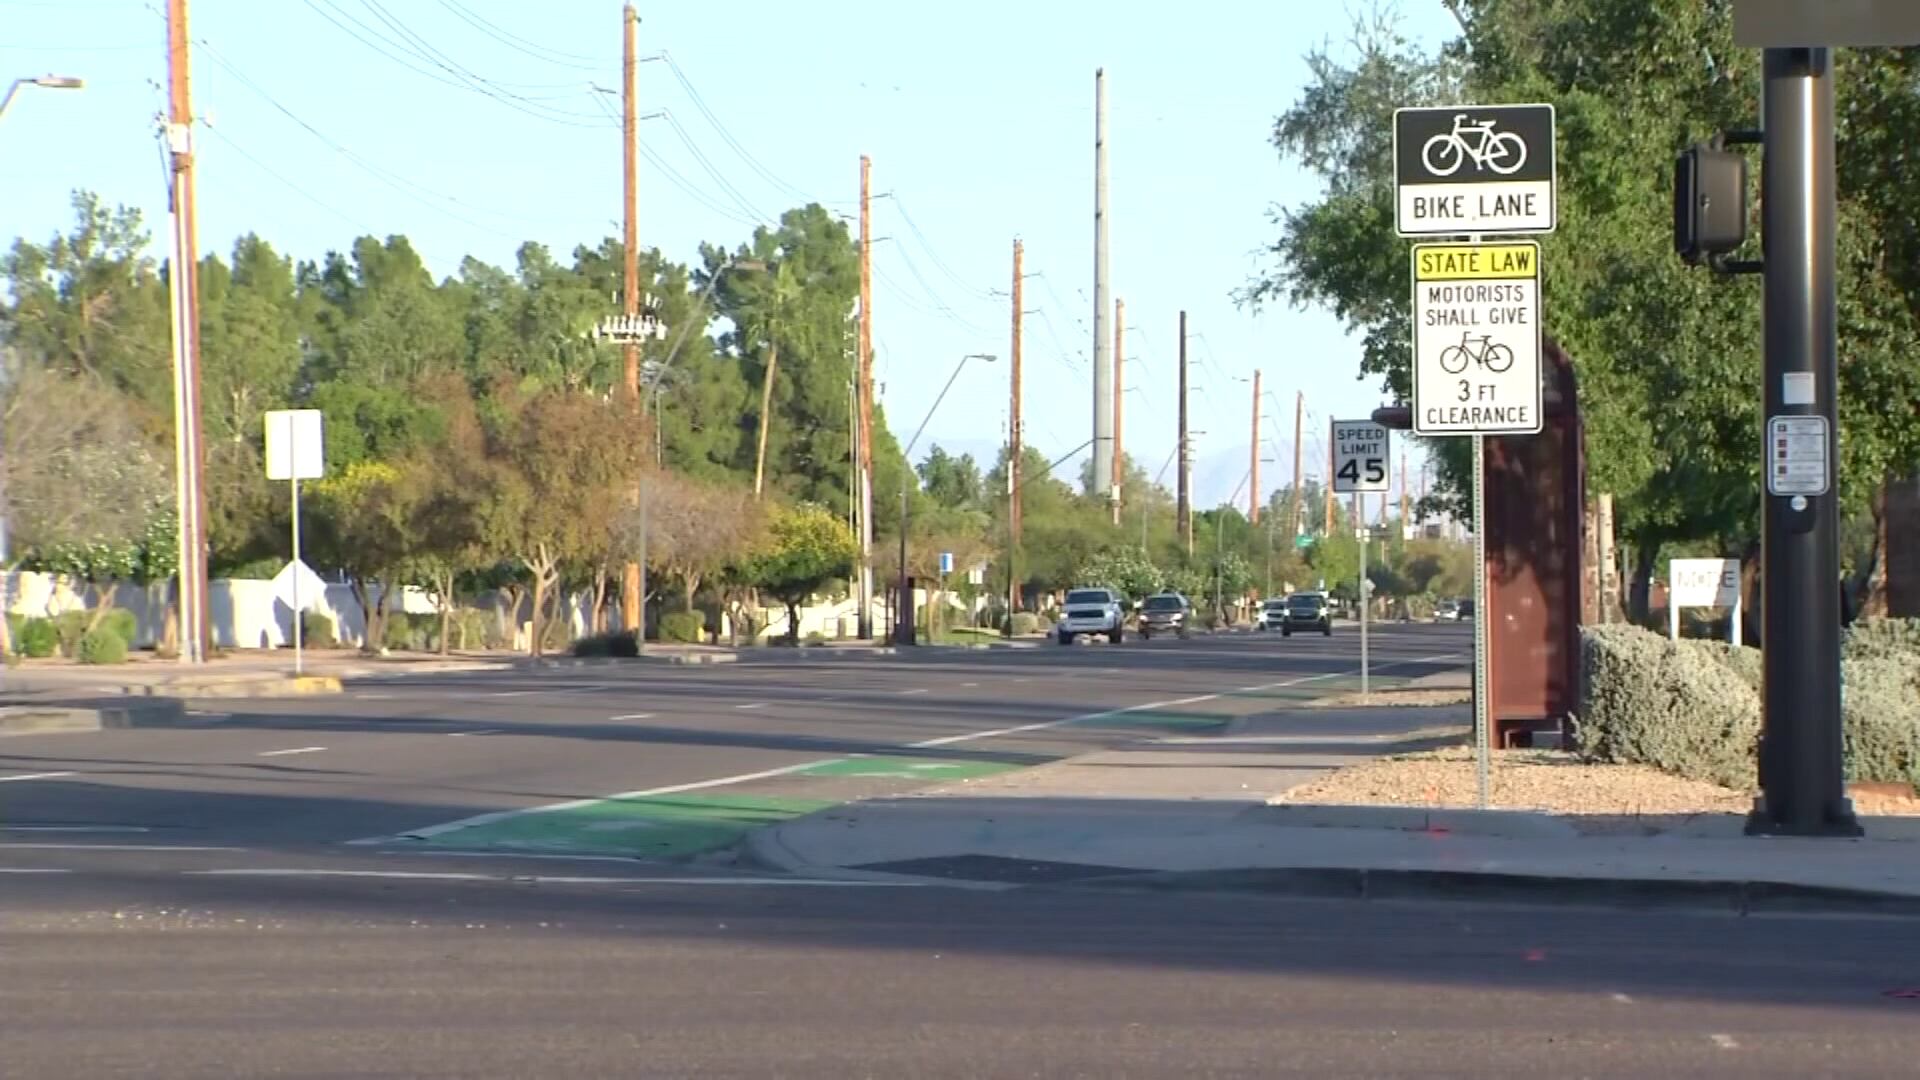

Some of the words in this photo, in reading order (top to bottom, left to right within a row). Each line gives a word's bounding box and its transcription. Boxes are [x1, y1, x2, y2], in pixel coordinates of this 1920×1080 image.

[1414, 196, 1464, 219] BIKE
[1479, 193, 1537, 217] LANE
[1421, 252, 1480, 273] STATE
[1491, 251, 1530, 271] LAW
[1428, 285, 1524, 304] MOTORISTS
[1426, 308, 1480, 326] SHALL
[1489, 307, 1528, 325] GIVE
[1458, 379, 1471, 402] 3
[1479, 384, 1496, 401] FT
[1427, 406, 1529, 424] CLEARANCE
[1337, 429, 1385, 440] SPEED
[1341, 443, 1380, 454] LIMIT
[1337, 458, 1385, 484] 45
